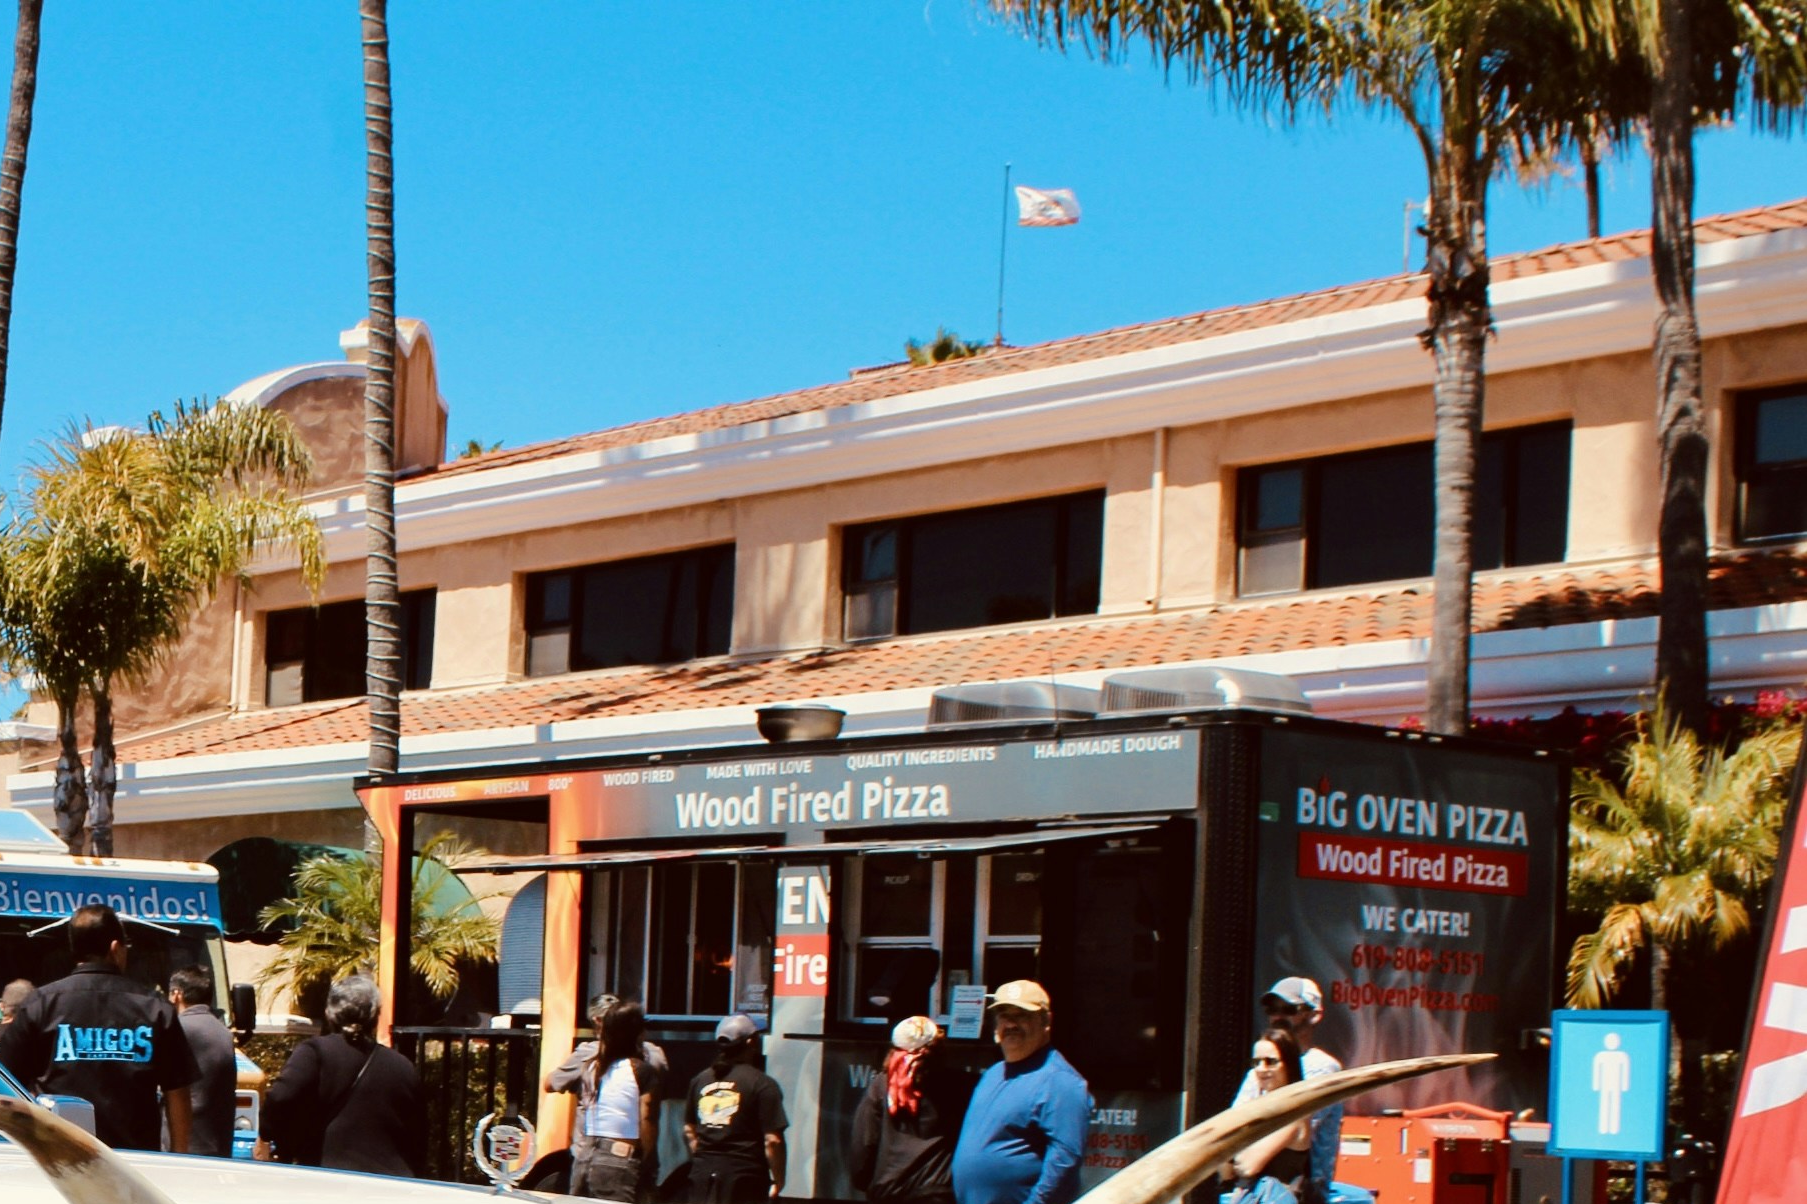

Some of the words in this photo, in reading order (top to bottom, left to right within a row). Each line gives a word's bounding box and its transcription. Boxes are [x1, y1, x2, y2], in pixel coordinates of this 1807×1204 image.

[404, 786, 456, 801] DELICIOUS
[483, 780, 530, 796] ARTISAN
[603, 772, 639, 787] WOOD
[641, 769, 674, 784] FIRED
[706, 765, 742, 780] MADE
[743, 762, 777, 777] WITH
[779, 759, 812, 775] LOVE
[846, 752, 904, 771] QUALITY
[904, 746, 996, 766] INGREDIENTS
[1034, 738, 1121, 759] HANDMADE
[1124, 735, 1182, 753] DOUGH
[675, 785, 760, 829] Wood
[770, 780, 851, 824] Fired
[861, 776, 950, 820] Pizza
[1355, 793, 1438, 837] OVEN
[1446, 803, 1529, 846] PIZZA
[1316, 843, 1382, 876] Wood
[1389, 848, 1447, 882] Fired
[1452, 854, 1509, 888] Pizza
[778, 875, 831, 925] EN
[1361, 904, 1396, 932] WE
[1399, 908, 1471, 937] CATER!
[1351, 944, 1485, 976] 619-808-5151
[1331, 978, 1499, 1011] BigOvenPizza.com
[54, 1023, 154, 1063] AMIGOS
